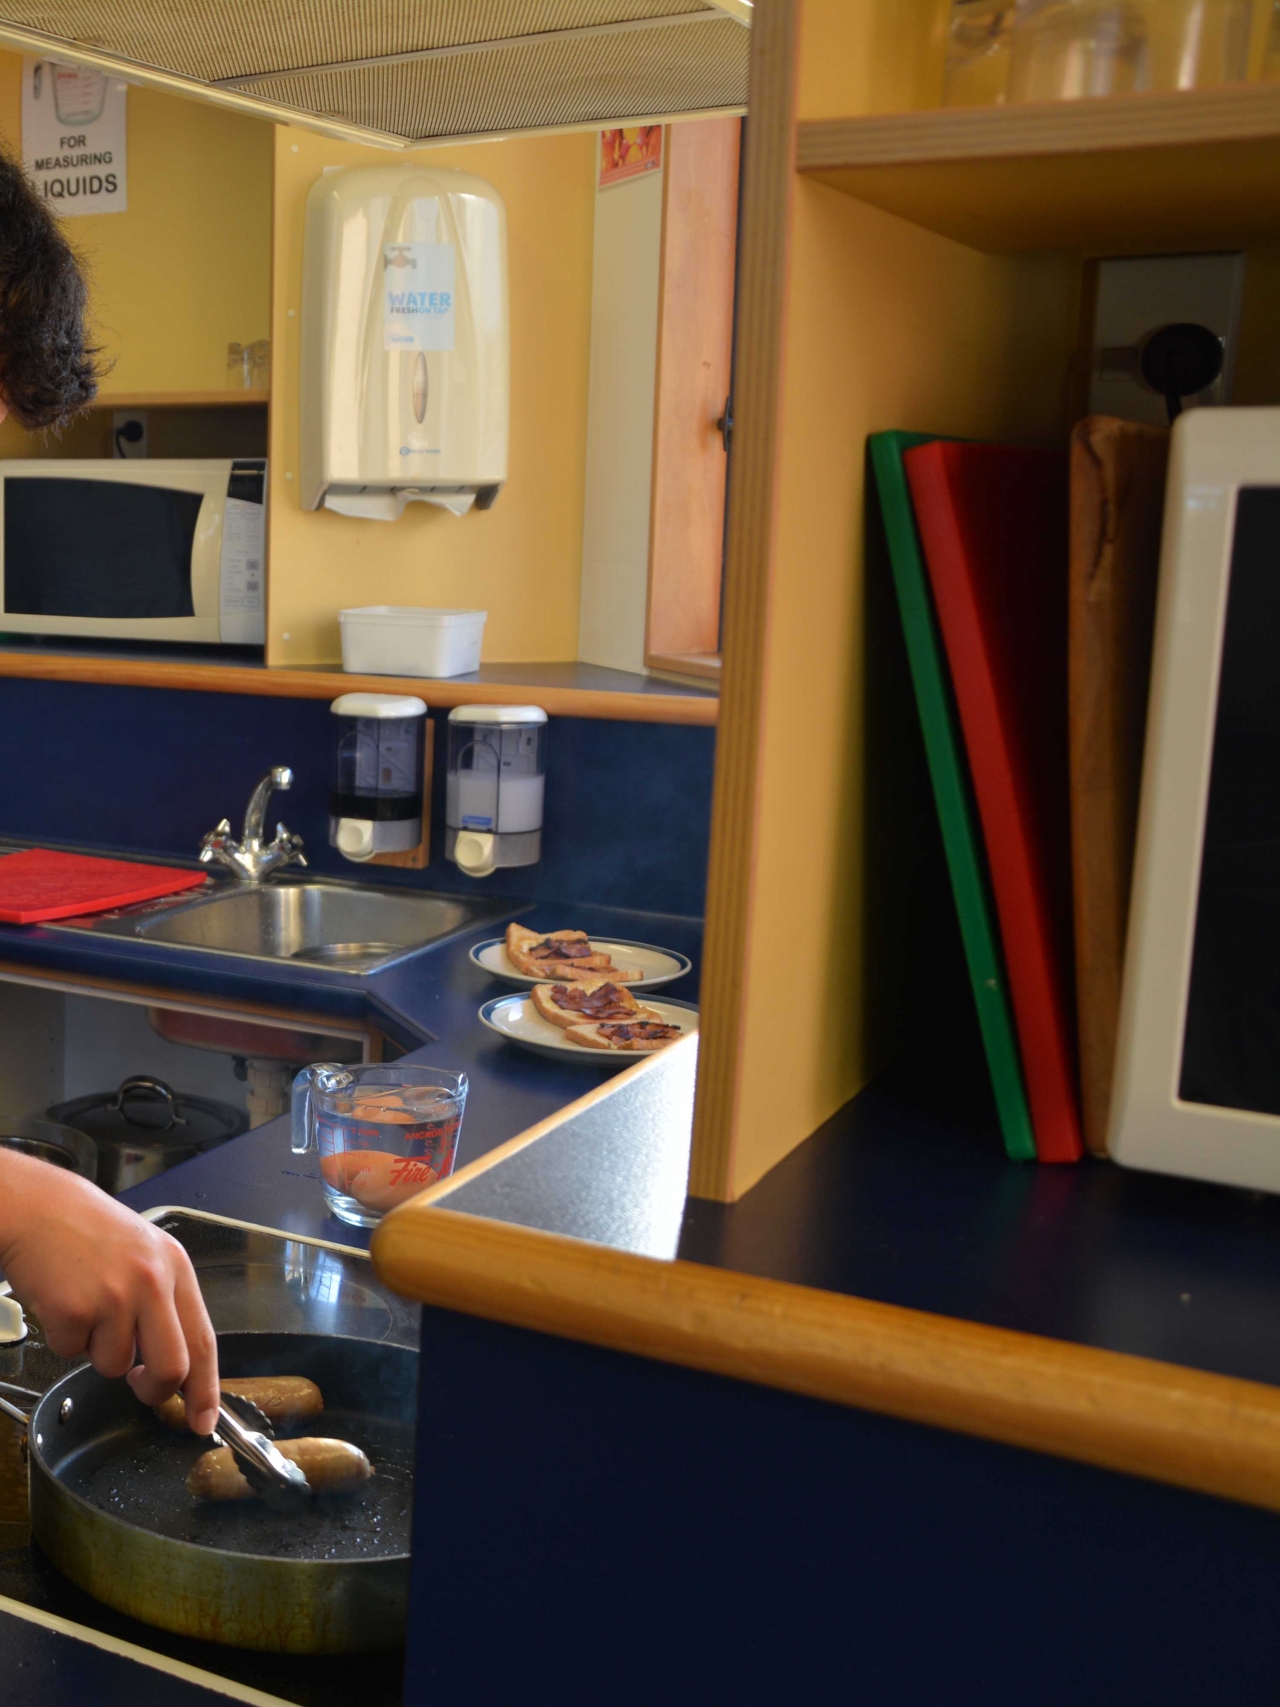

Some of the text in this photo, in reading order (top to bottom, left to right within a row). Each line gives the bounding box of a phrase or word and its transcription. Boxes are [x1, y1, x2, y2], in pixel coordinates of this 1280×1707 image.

[60, 135, 87, 149] FOR
[35, 151, 113, 171] MEASURING
[43, 173, 118, 198] IQUIDS
[388, 291, 451, 307] WATER
[389, 1156, 431, 1186] Fire
